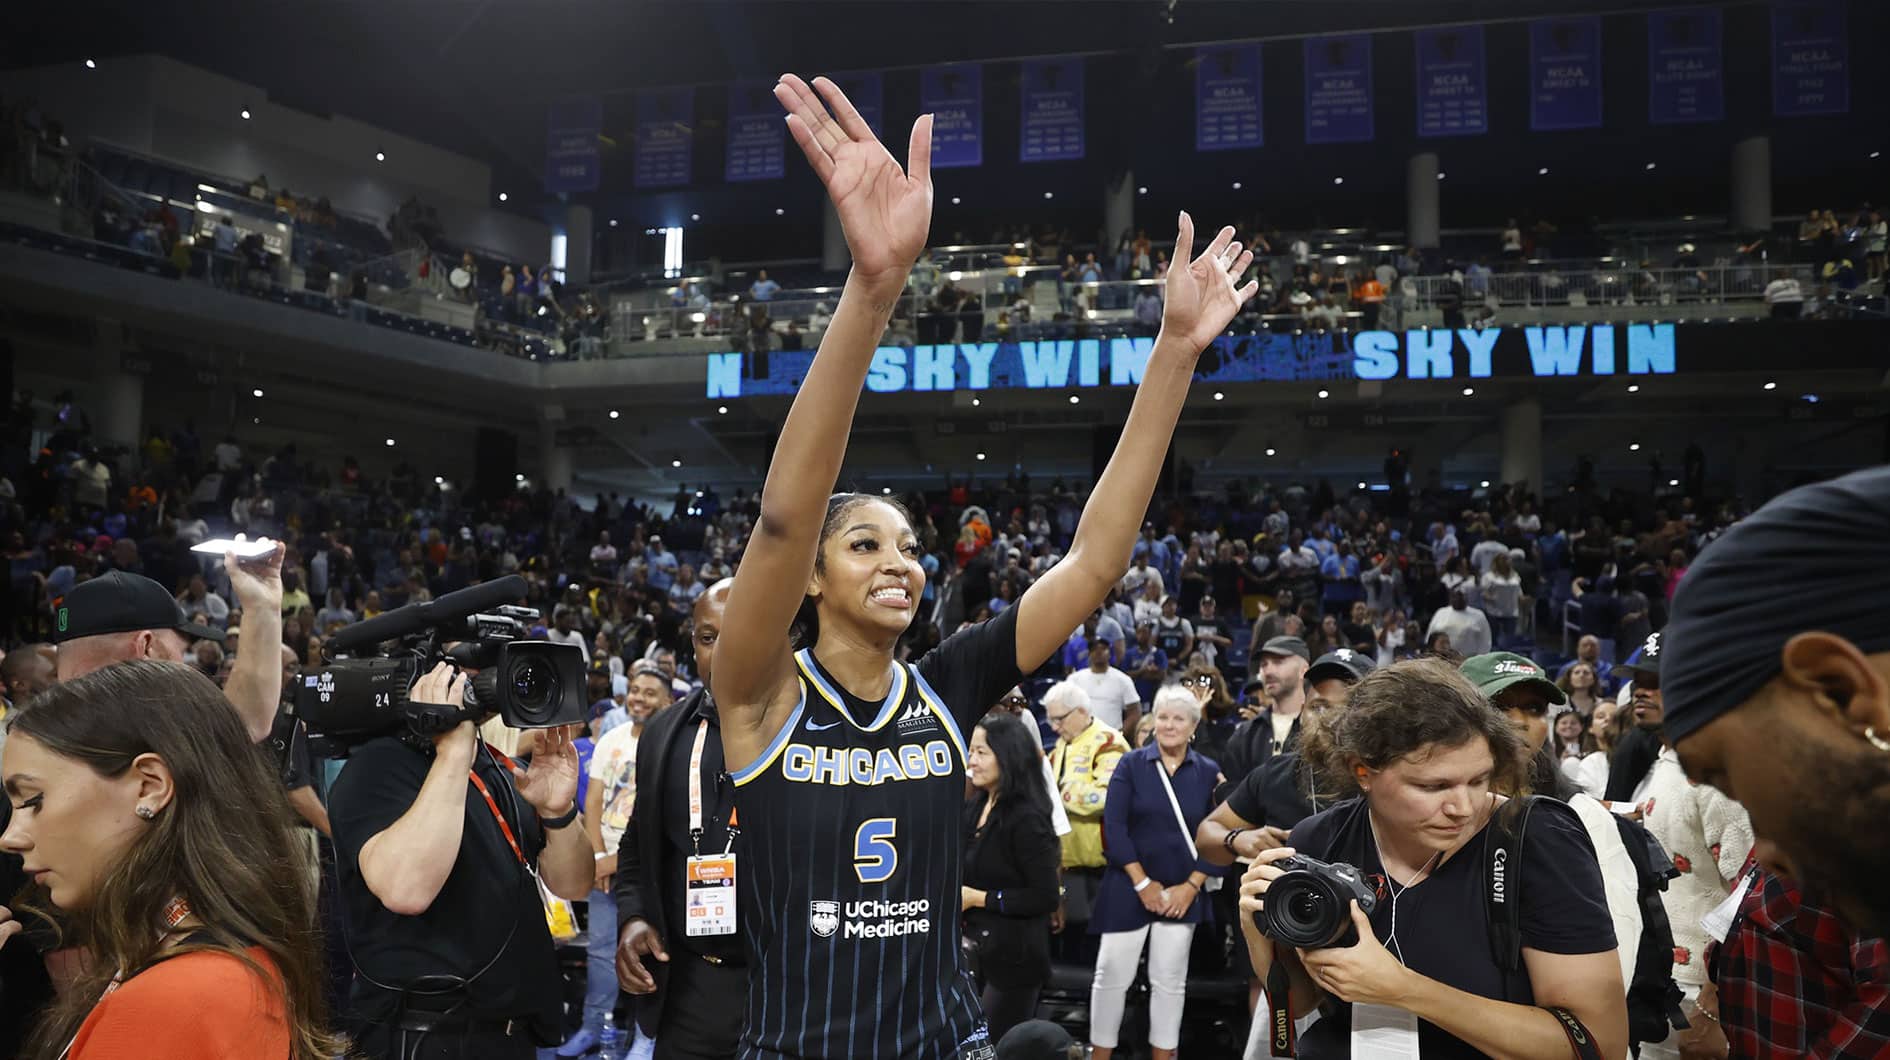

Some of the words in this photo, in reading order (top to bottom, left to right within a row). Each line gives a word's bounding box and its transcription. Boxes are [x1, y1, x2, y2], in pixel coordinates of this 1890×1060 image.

[1433, 74, 1469, 86] NCAA
[1547, 66, 1584, 77] NCAA
[1213, 87, 1245, 97] NCAA
[1322, 79, 1354, 89] NCAA
[1353, 327, 1501, 380] SKY
[1525, 323, 1676, 376] WIN
[866, 342, 999, 392] SKY
[1020, 337, 1155, 388] WIN
[317, 682, 335, 692] CAM
[320, 692, 330, 702] 09
[782, 740, 952, 785] CHICAGO
[853, 817, 898, 883] 5
[1493, 848, 1507, 903] Canon
[844, 899, 929, 918] UChicago
[844, 918, 930, 939] Medicine
[1276, 1009, 1287, 1050] Canon
